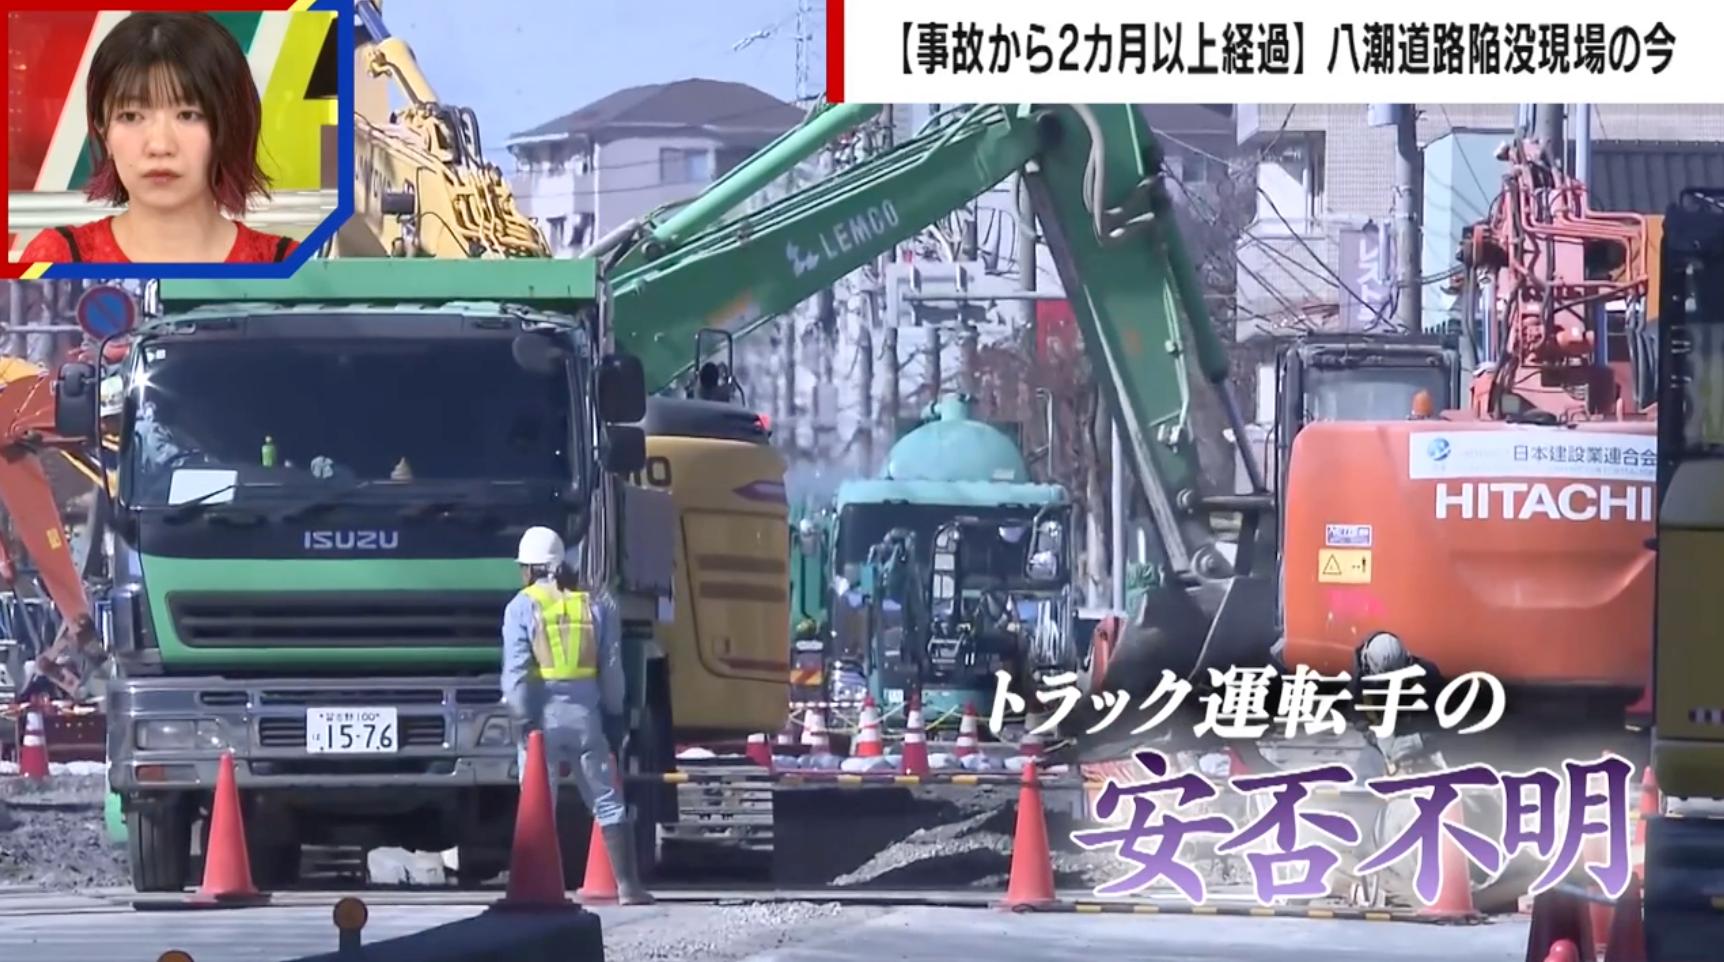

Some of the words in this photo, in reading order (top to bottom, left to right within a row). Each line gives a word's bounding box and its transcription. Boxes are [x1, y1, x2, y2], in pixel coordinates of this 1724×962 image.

[819, 199, 899, 259] LEMCO
[1513, 443, 1657, 466] 日本建設業連合会
[1435, 482, 1651, 521] HITACHI
[303, 531, 399, 549] ISUZU
[327, 723, 392, 749] 15-76
